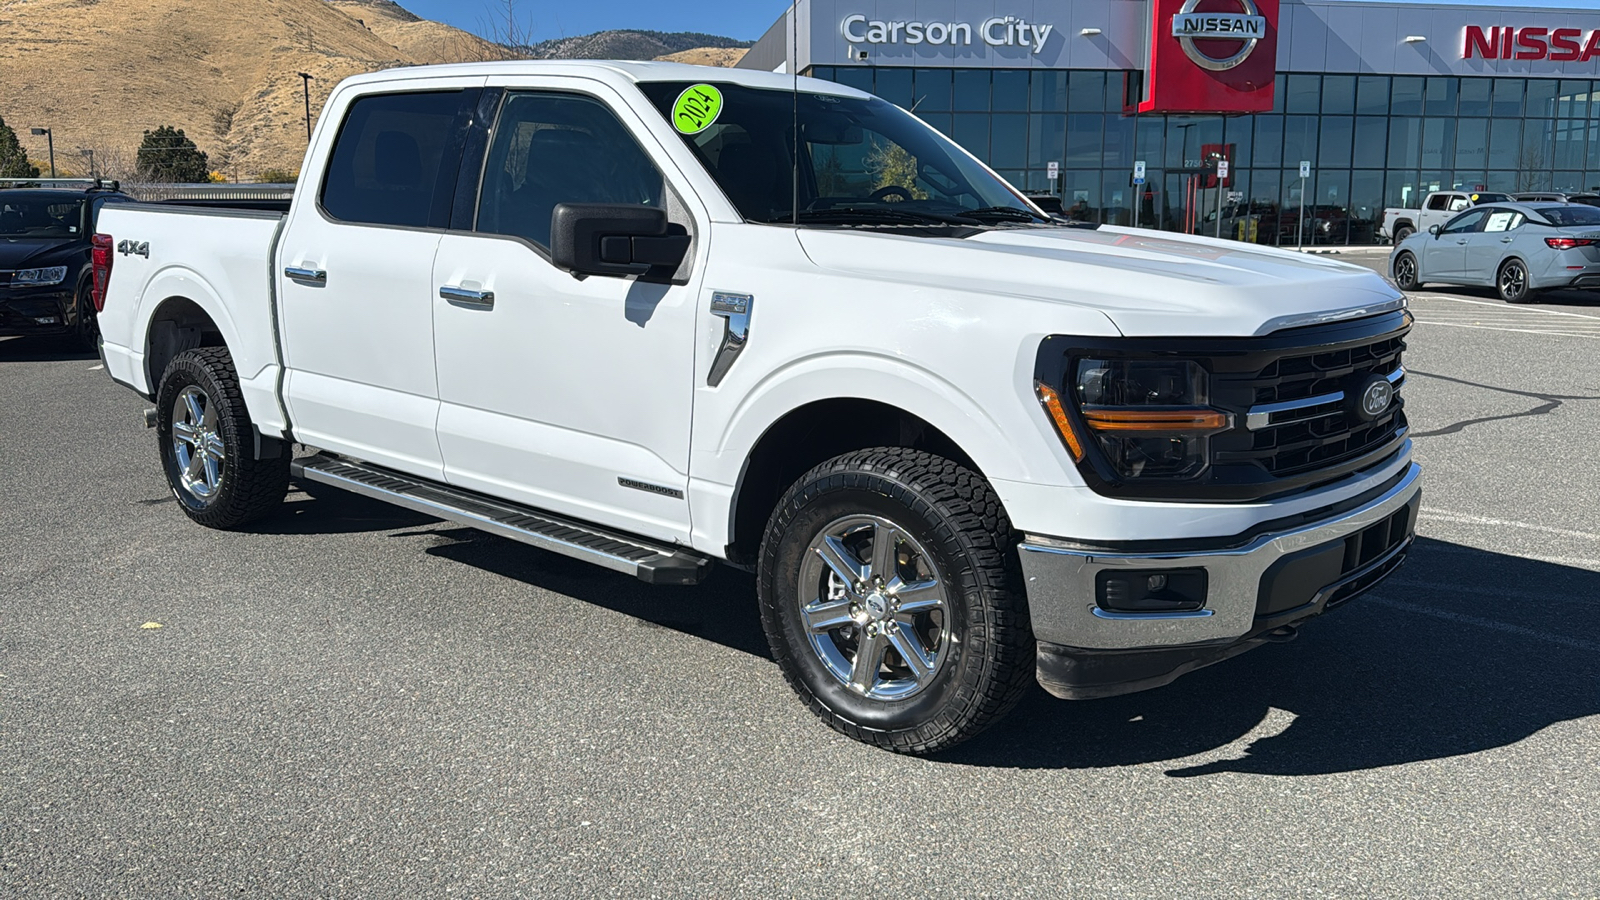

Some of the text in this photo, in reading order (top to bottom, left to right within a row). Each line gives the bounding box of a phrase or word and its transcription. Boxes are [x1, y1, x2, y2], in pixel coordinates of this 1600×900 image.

[841, 14, 1054, 53] Carson City
[1184, 18, 1258, 34] NISSAN
[678, 88, 714, 129] 2024
[1368, 385, 1389, 411] Ford
[619, 477, 679, 496] POWERBOOST
